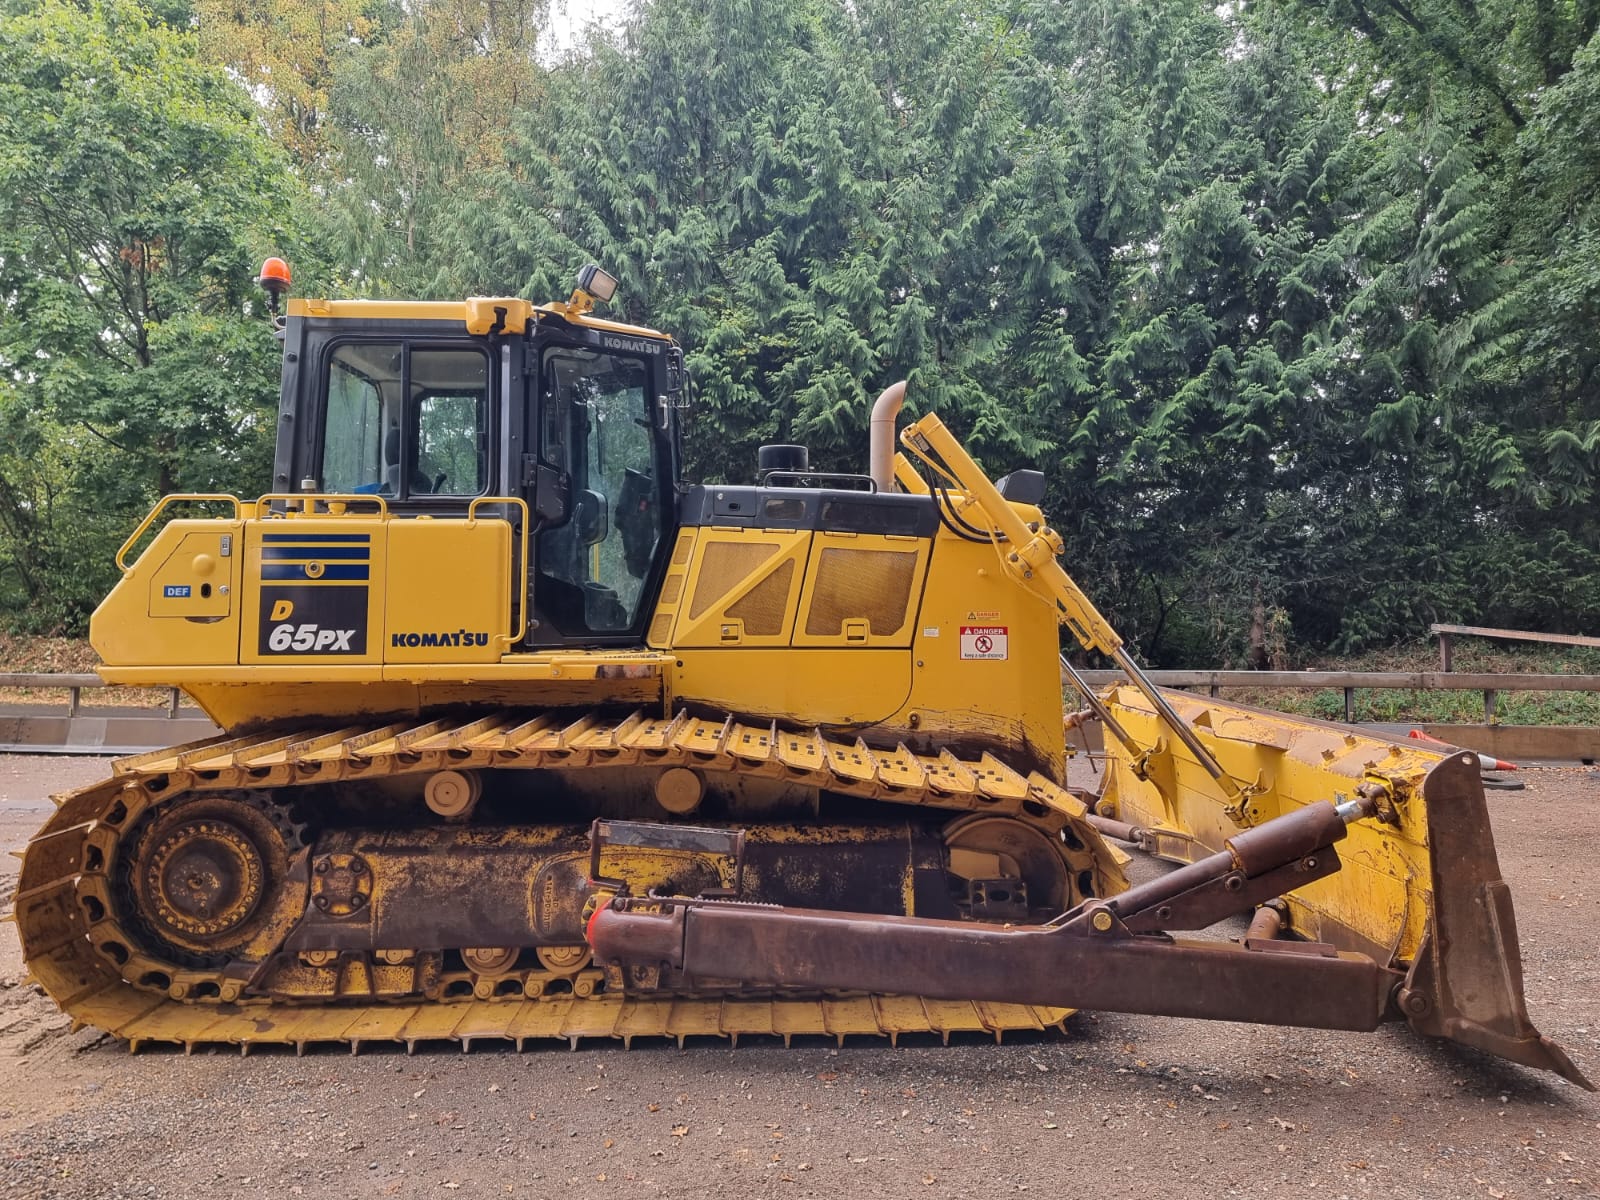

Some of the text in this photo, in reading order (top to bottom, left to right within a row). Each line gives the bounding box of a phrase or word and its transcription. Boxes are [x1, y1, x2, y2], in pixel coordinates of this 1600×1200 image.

[604, 337, 660, 354] KOMATSU
[167, 587, 189, 596] DEF
[270, 600, 294, 621] D
[268, 624, 356, 651] 65PX
[391, 629, 489, 647] KOMATSU
